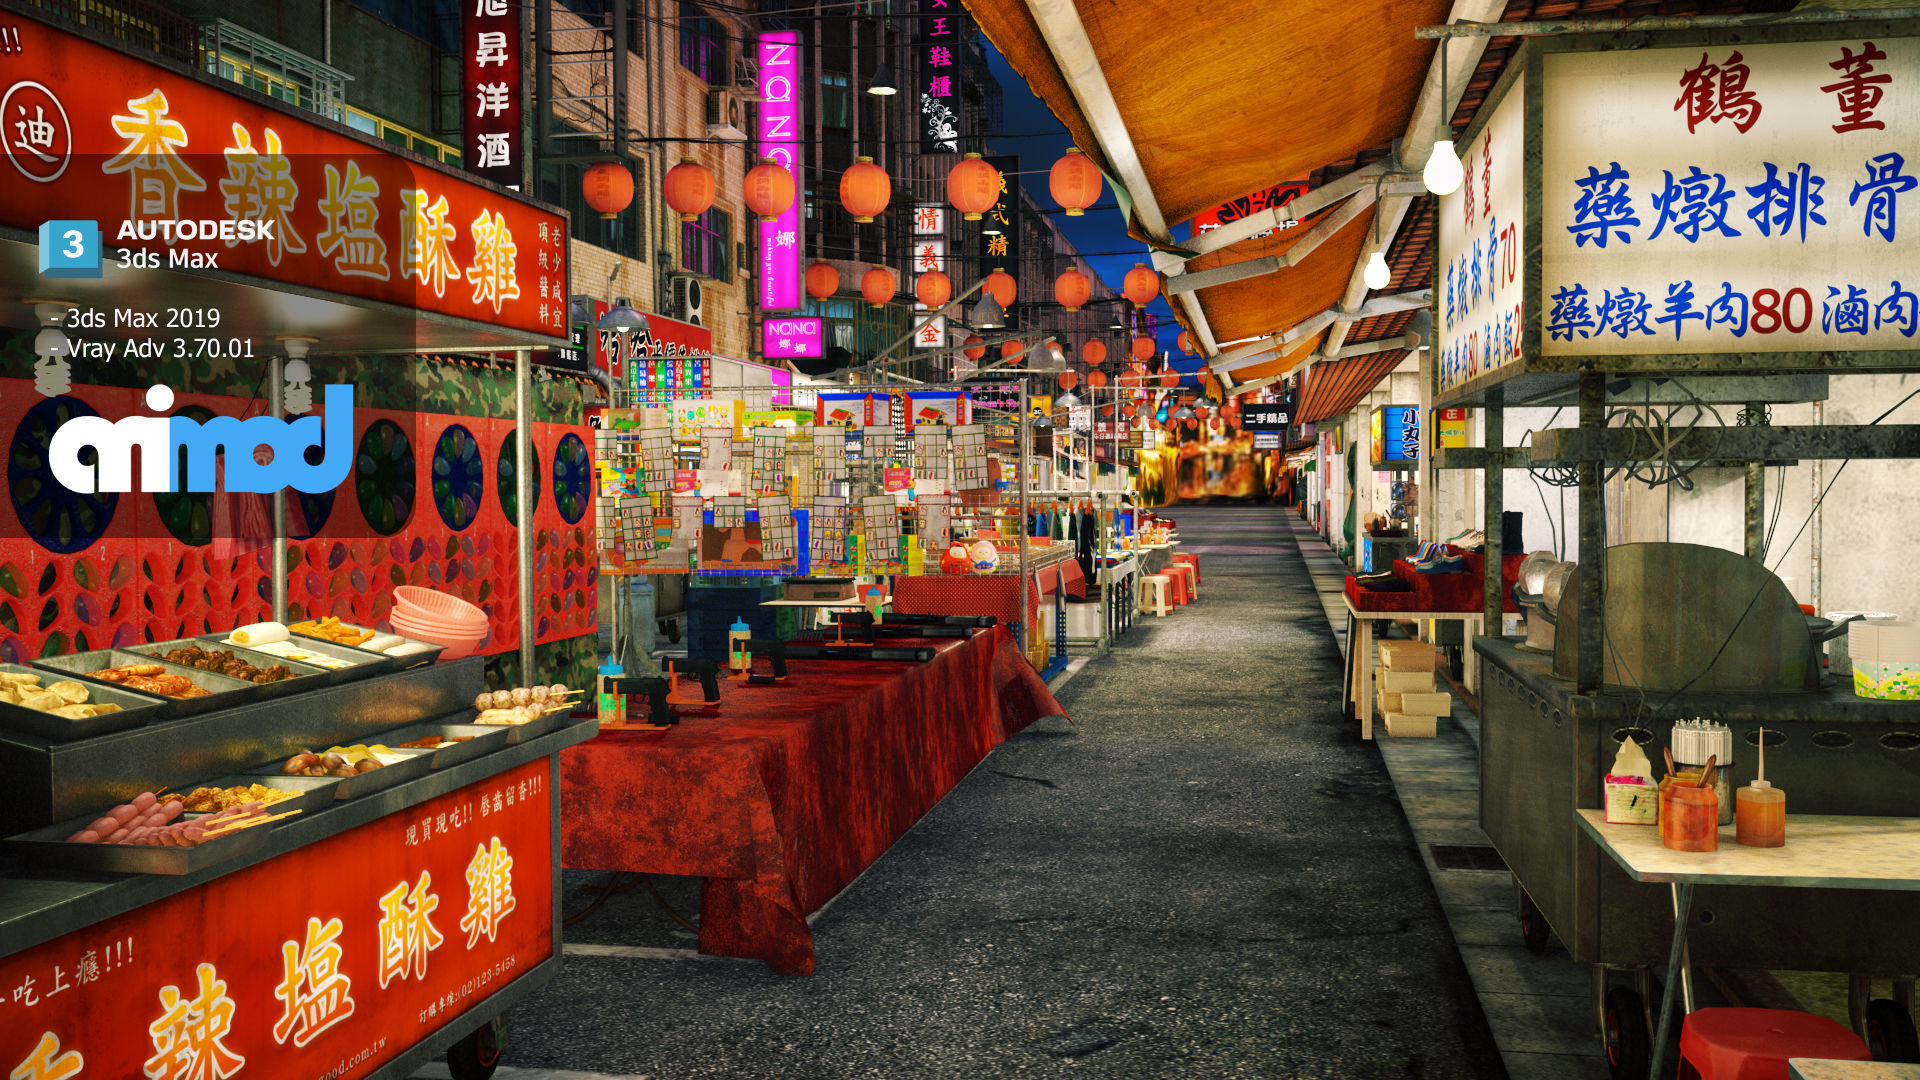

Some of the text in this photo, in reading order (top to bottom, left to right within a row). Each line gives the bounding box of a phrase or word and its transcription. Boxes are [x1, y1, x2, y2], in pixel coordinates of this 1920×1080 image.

[15, 104, 59, 164] 迪
[1566, 152, 1919, 249] 藥燉排骨
[1822, 280, 1920, 338] 滷肉
[0, 936, 133, 1007] 吃上癮!!!
